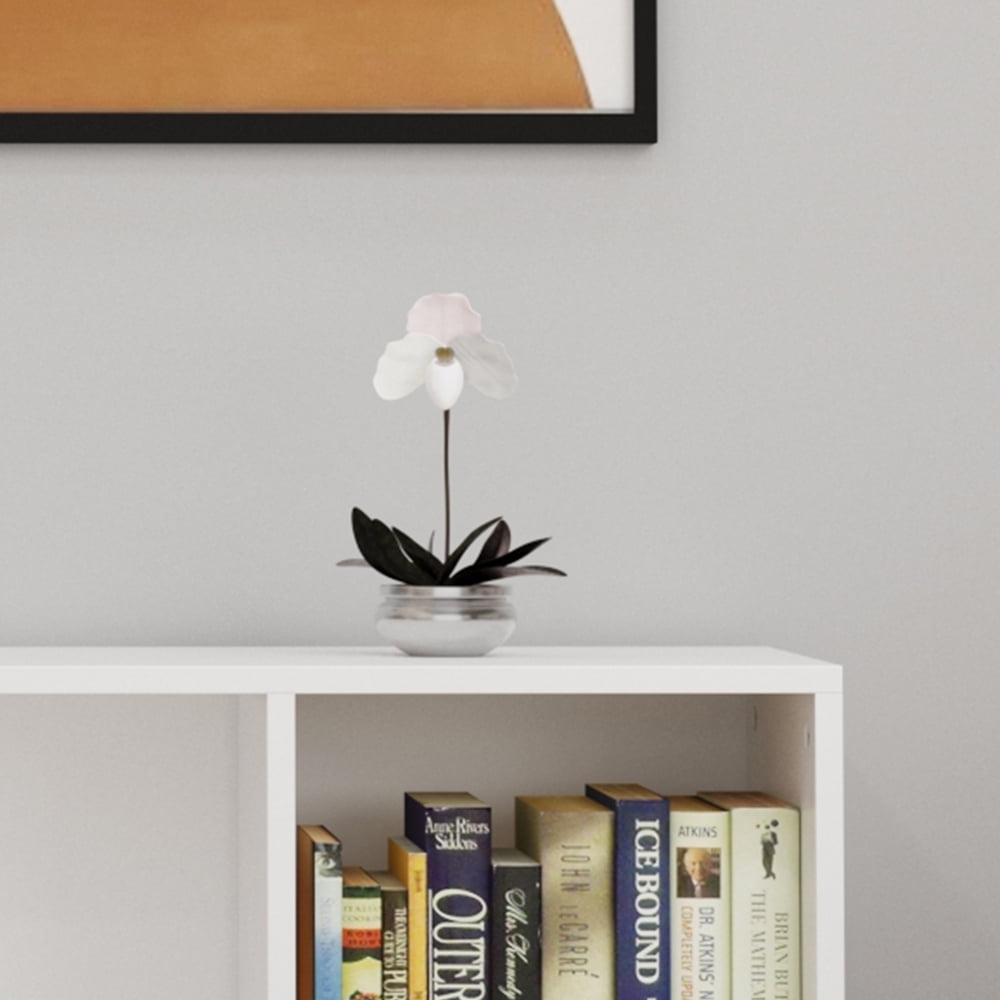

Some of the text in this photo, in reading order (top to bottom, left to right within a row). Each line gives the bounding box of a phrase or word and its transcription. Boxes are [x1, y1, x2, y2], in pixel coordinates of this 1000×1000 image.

[677, 825, 718, 839] ATKINS
[560, 843, 592, 893] JOHN
[505, 887, 528, 934] Mrs.
[634, 872, 660, 985] BOUND
[699, 906, 714, 929] DR.
[751, 889, 767, 926] THE
[681, 905, 693, 972] COMPLETELY
[773, 912, 789, 965] BRIAN
[497, 931, 531, 1000] Kennedy
